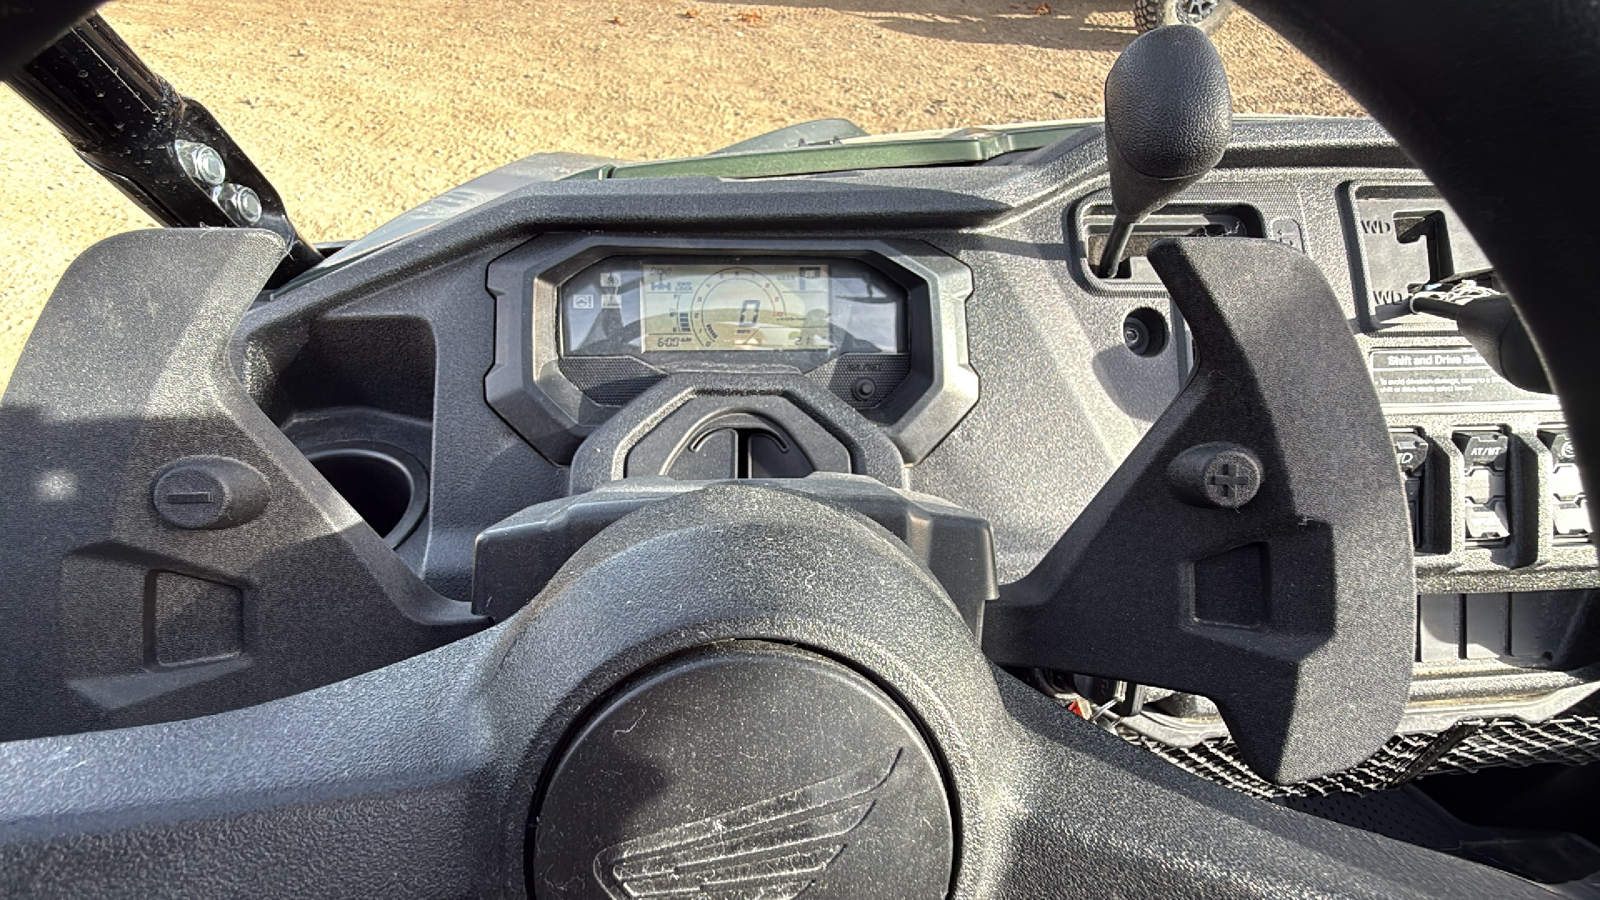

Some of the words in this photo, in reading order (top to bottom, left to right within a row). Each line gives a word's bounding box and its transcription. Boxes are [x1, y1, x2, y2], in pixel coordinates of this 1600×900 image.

[1361, 220, 1391, 234] WD
[1373, 290, 1403, 305] WD
[739, 299, 761, 327] 0
[1388, 355, 1412, 366] Shift
[1413, 355, 1433, 365] and
[1434, 354, 1462, 365] Drive
[1470, 447, 1502, 456] AT/MT
